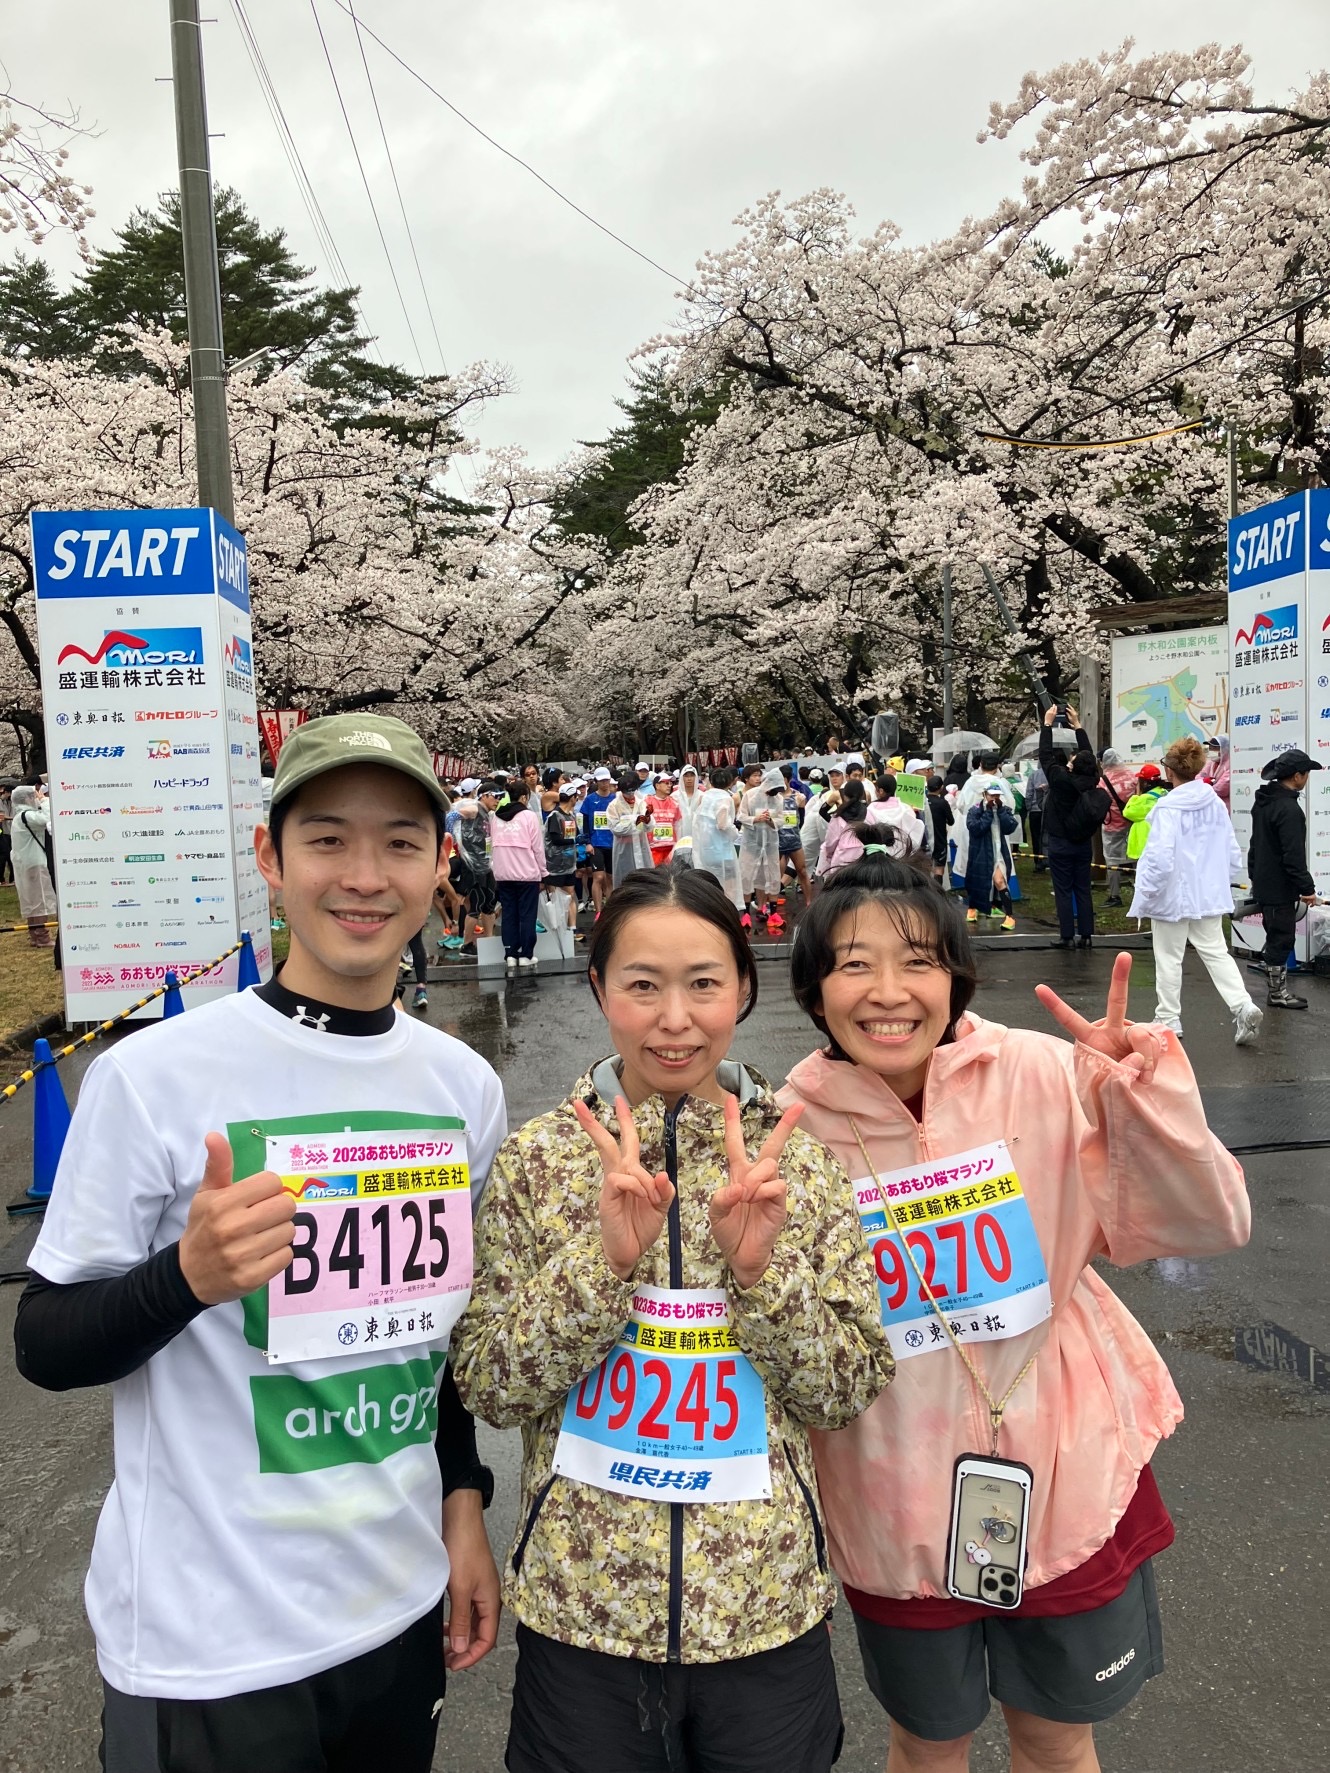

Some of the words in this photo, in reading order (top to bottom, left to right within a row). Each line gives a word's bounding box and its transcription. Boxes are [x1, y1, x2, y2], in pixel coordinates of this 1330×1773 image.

[47, 527, 200, 580] START
[1232, 511, 1301, 576] START
[218, 533, 246, 594] START
[1138, 634, 1218, 653] 野木和公園案内板
[1257, 625, 1295, 644] MORI
[109, 650, 196, 666] MORI
[1149, 651, 1206, 662] ようこそ野木和公園へ
[58, 668, 206, 690] 盛運輸株式会社
[73, 711, 125, 725] 東奥日報
[146, 710, 218, 720] カクヒログループ
[62, 746, 125, 759] 県民共済
[333, 1142, 453, 1163] 2023あおもり桜マラソン
[306, 1187, 354, 1198] MORI
[363, 1167, 465, 1193] 盛運輸株式会社
[893, 1177, 1016, 1224] 盛運輸株式会社
[284, 1198, 450, 1296] B4125
[872, 1212, 1012, 1311] 9270
[364, 1311, 435, 1342] 東奥日報
[576, 1352, 740, 1441] D9245
[285, 1383, 380, 1439] arch
[607, 1461, 713, 1491] 県民共済
[1095, 1647, 1136, 1682] adidas
